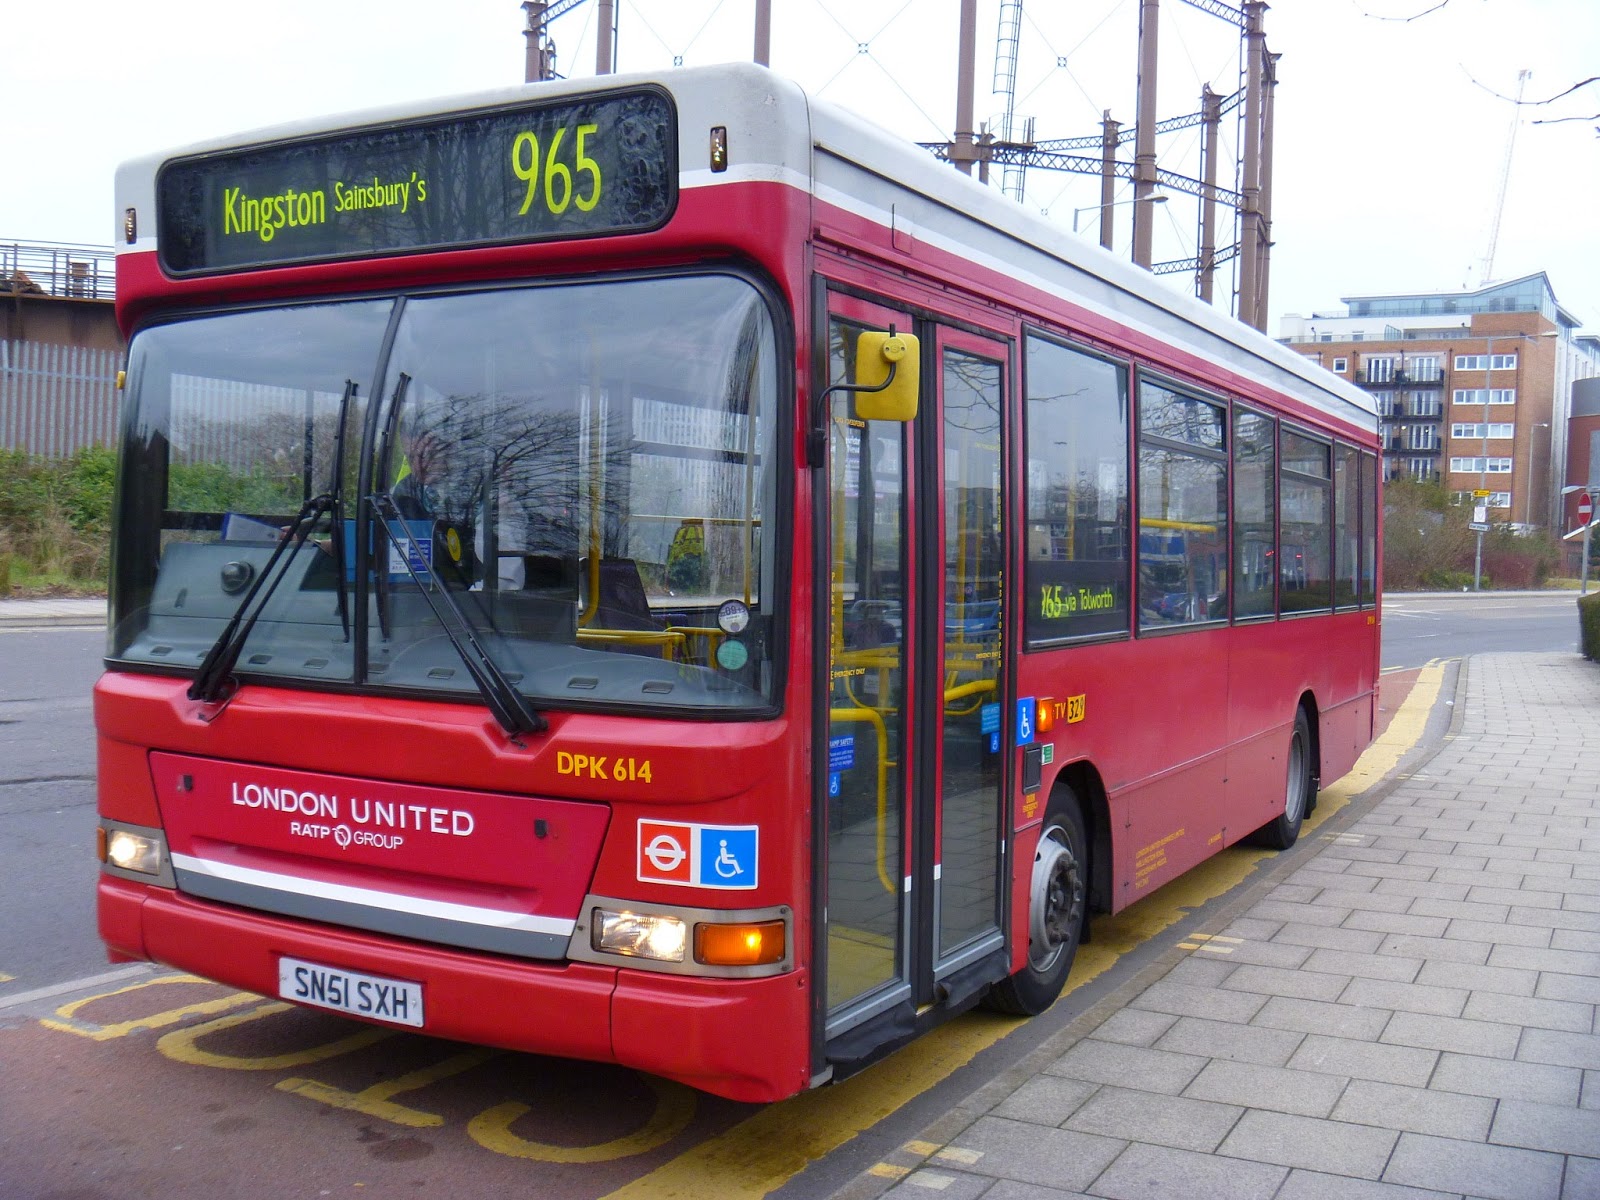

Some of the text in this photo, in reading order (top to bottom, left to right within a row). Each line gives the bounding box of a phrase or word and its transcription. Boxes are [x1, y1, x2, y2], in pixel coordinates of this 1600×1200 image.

[225, 124, 601, 242] Kingston Sainsbury's 965
[1065, 592, 1076, 612] via
[1079, 587, 1113, 611] Tolworth
[1054, 702, 1066, 720] TV
[557, 751, 652, 783] DPK 614
[232, 782, 475, 836] LONDON UNITED
[290, 821, 403, 850] RATP GROUP
[294, 966, 408, 1019] SN51 SXH
